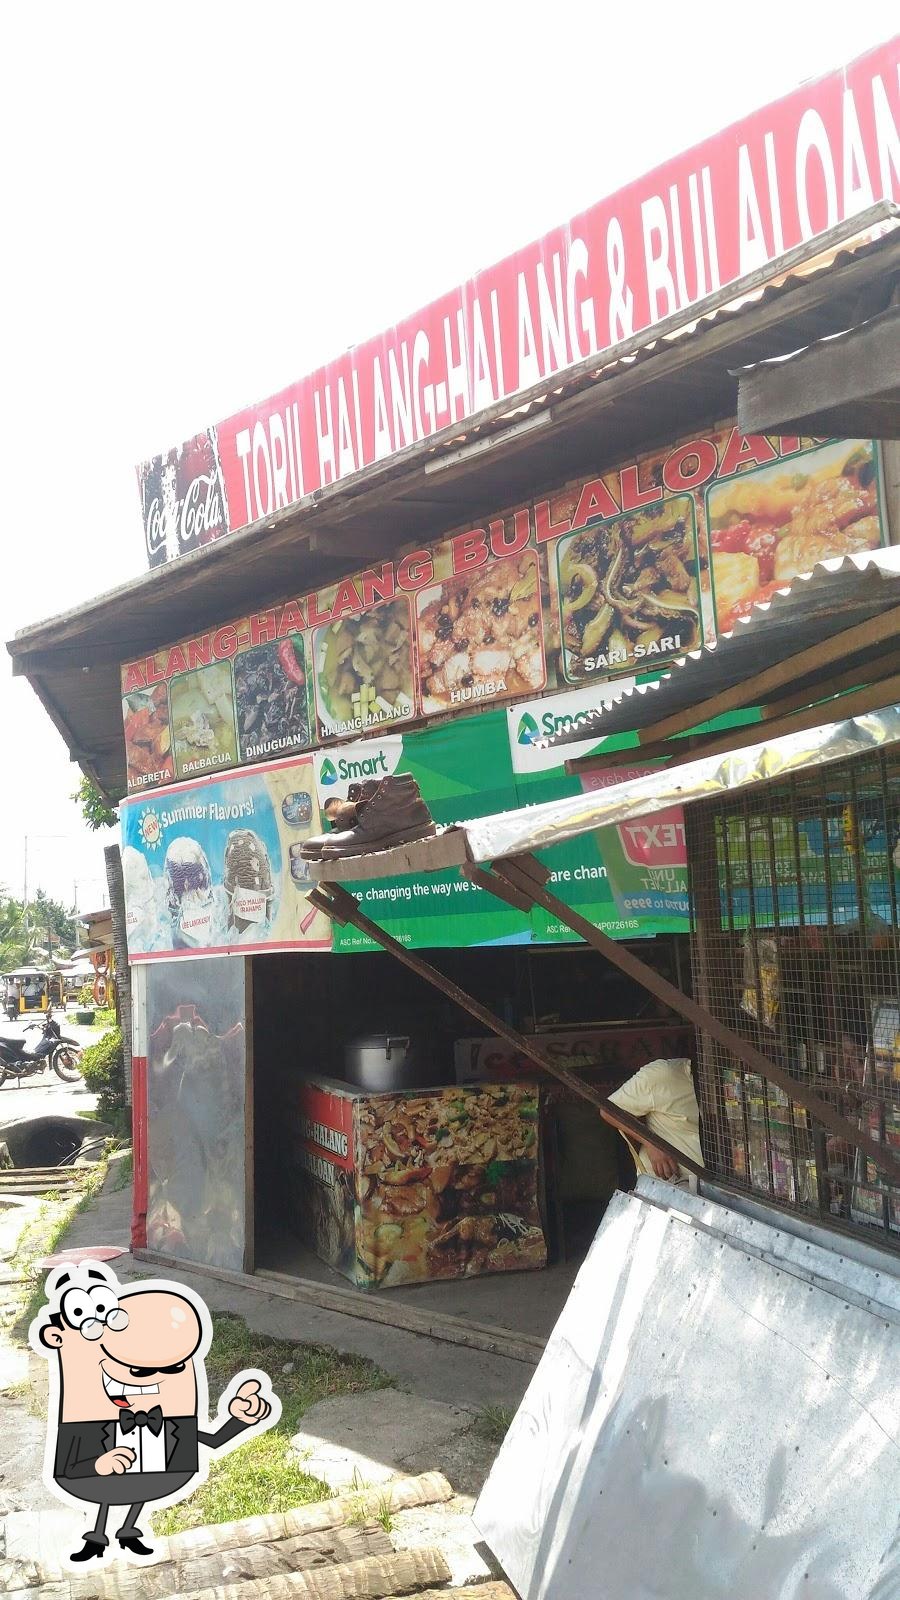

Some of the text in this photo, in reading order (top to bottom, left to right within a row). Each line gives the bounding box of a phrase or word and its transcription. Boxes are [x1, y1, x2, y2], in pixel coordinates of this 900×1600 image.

[606, 216, 634, 346] &
[147, 472, 223, 555] Coca-Cola
[584, 634, 682, 673] SARI-SARI
[450, 680, 508, 704] HUMBA
[320, 703, 411, 737] HALANG-HALANG
[245, 734, 301, 758] DINUGUAN
[182, 752, 232, 774] BALBACUA
[338, 750, 389, 780] Smart
[161, 797, 255, 828] Summer Flavors!
[144, 821, 159, 837] NEW
[550, 868, 575, 883] are
[352, 891, 362, 901] re
[365, 883, 411, 902] changing
[413, 881, 430, 896] the
[432, 882, 451, 897] way
[453, 881, 469, 892] we
